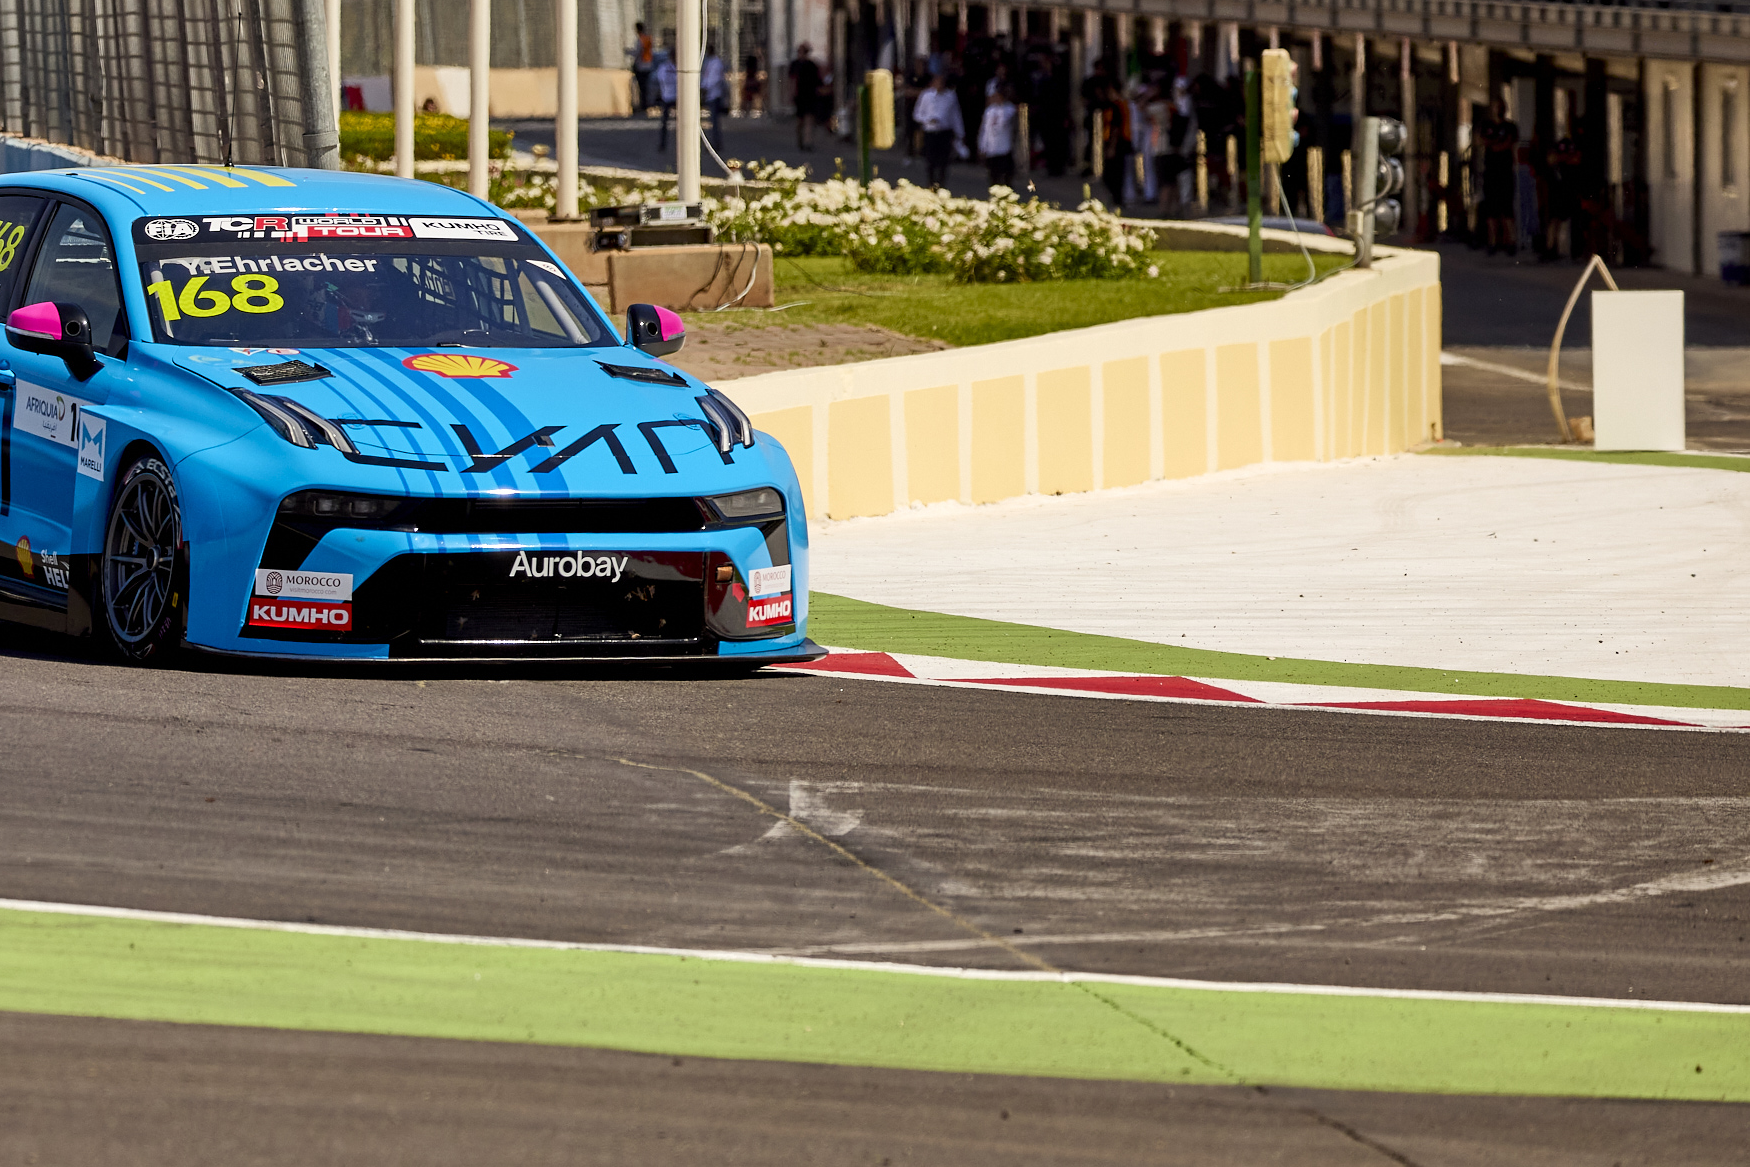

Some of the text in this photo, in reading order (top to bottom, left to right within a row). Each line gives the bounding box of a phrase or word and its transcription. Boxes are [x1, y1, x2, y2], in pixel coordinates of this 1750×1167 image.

[202, 217, 290, 232] TCR
[314, 226, 405, 237] TOUR
[422, 221, 501, 231] KUMHO
[474, 229, 508, 237] TIRE
[180, 254, 377, 276] Y.Ehrlacher
[147, 274, 284, 322] 168
[26, 396, 58, 420] AFRIQUIA
[80, 456, 102, 473] MARELLI
[41, 549, 58, 566] Shell
[509, 550, 628, 583] Aurobay
[286, 575, 341, 588] MOROCCO
[762, 570, 786, 582] MOROCCO
[289, 586, 337, 595] visitmorocco.com
[253, 605, 349, 625] KUMHO
[748, 600, 791, 622] KUMHO
